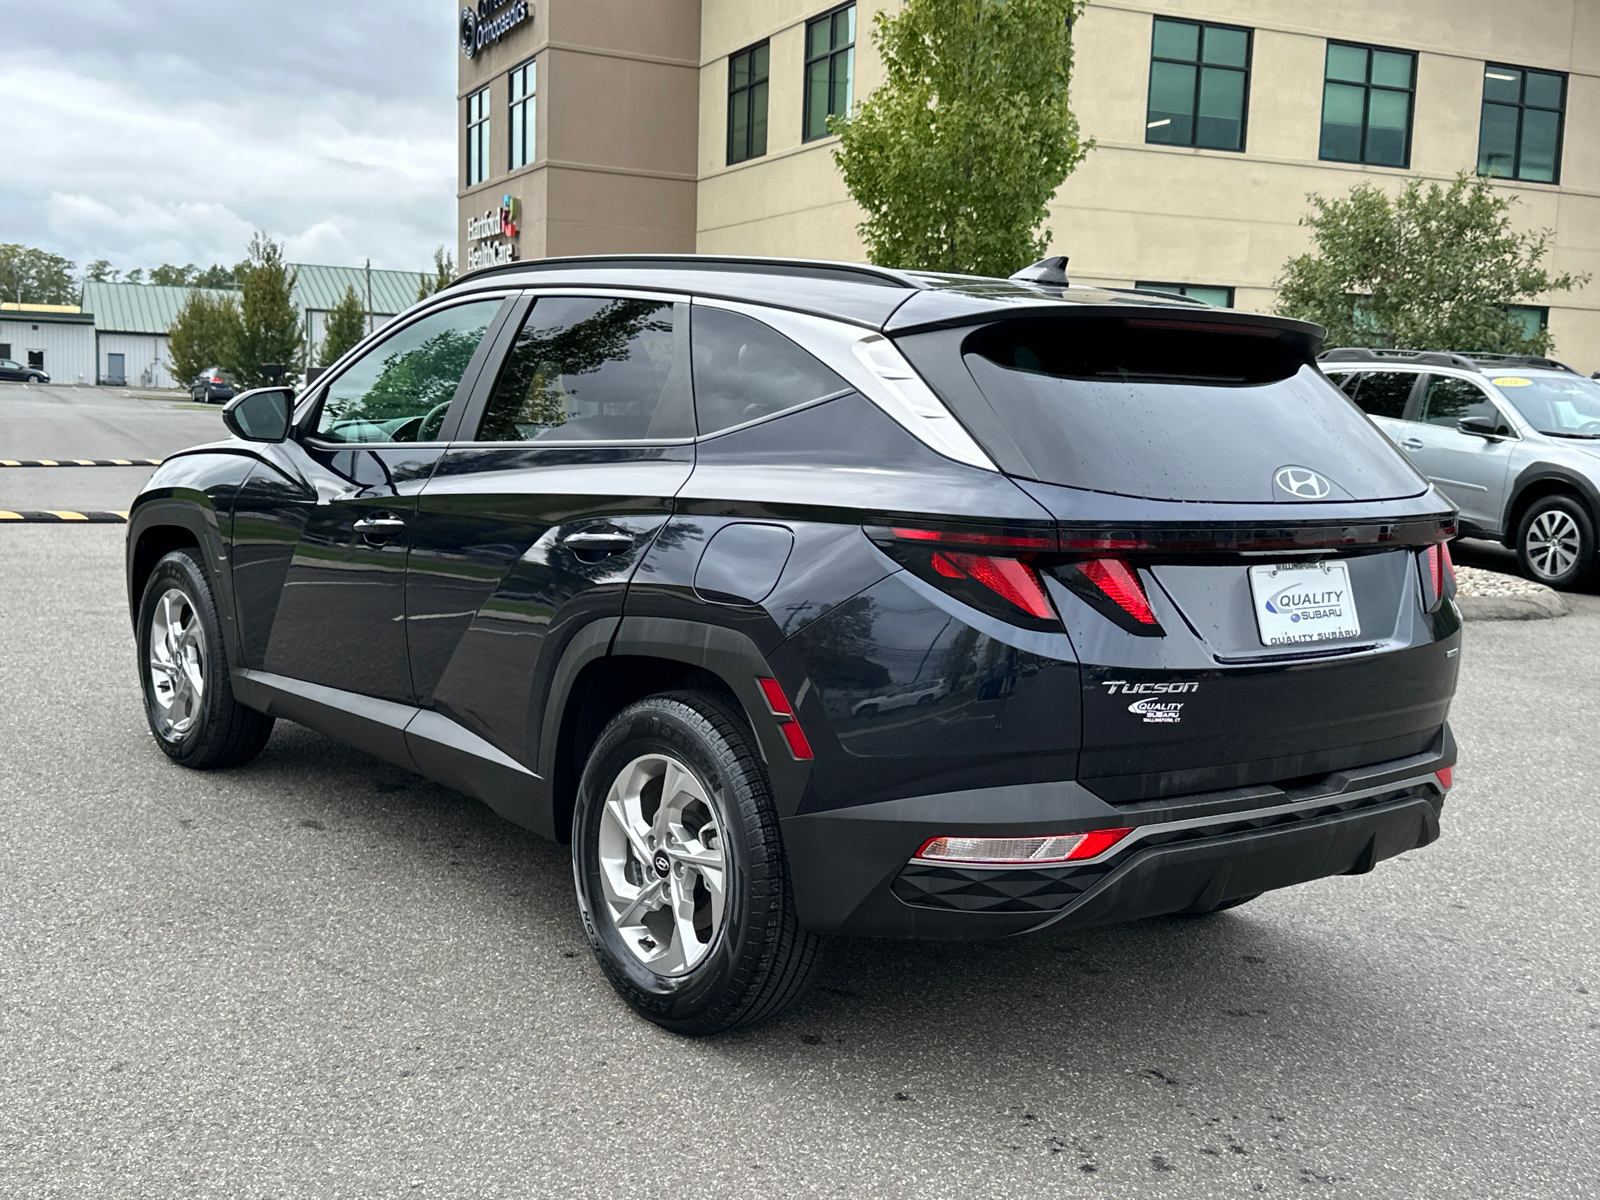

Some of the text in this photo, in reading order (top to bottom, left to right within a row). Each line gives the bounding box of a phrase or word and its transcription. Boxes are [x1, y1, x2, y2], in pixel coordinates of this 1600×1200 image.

[467, 207, 502, 241] Hartford
[467, 240, 513, 271] HealthCare
[1280, 590, 1344, 607] QUALITY
[1301, 608, 1342, 620] SUBARU
[1270, 629, 1358, 645] QUALITY SUBARU
[1138, 702, 1184, 711] QUALITY
